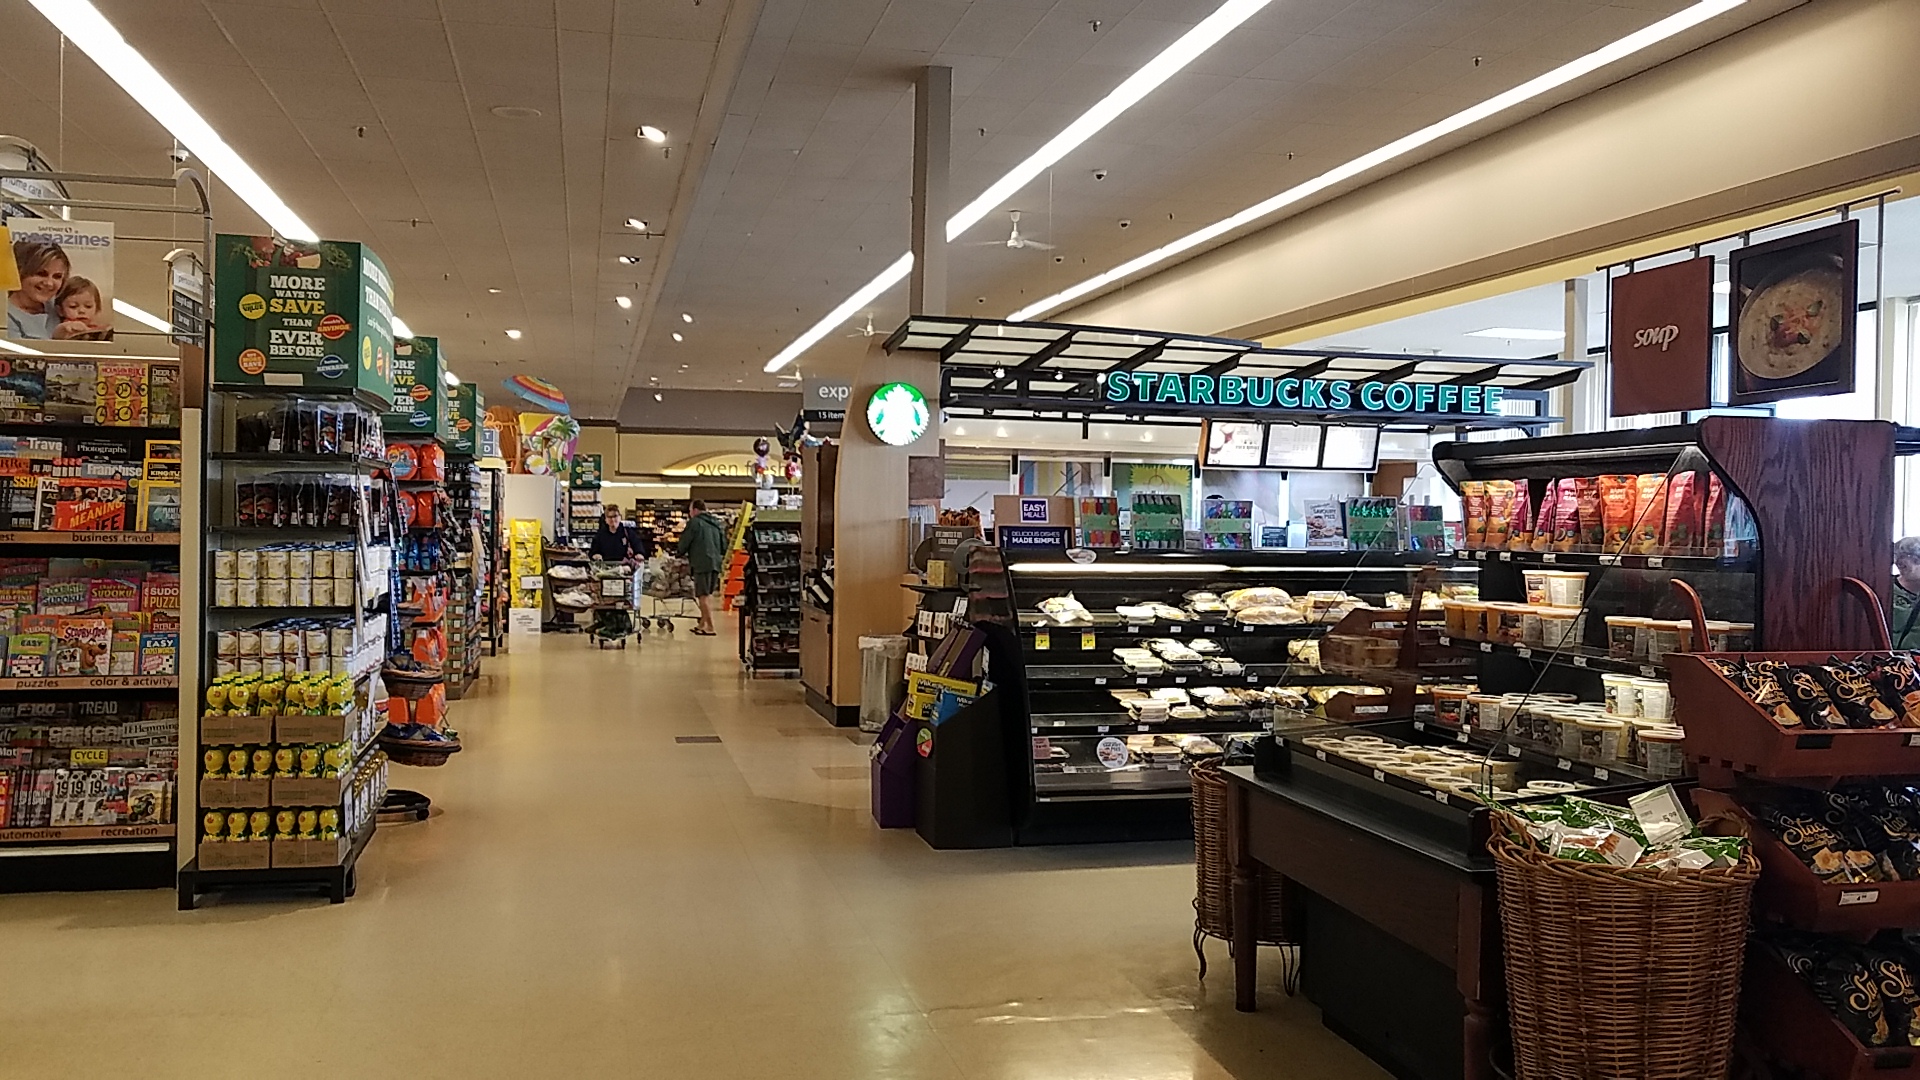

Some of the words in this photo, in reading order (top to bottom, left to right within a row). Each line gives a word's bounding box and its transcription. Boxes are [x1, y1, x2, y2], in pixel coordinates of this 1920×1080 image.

[28, 184, 42, 198] care
[12, 231, 110, 247] magazines
[270, 275, 325, 291] MORE
[275, 290, 304, 298] WAYS
[307, 291, 320, 299] TO
[269, 298, 325, 314] SAVE
[282, 318, 312, 327] THAN
[317, 324, 350, 332] SAVINGS
[269, 330, 323, 345] EVER
[1633, 324, 1680, 352] soup
[269, 345, 324, 357] BEFORE
[317, 364, 350, 372] REWARDS
[393, 360, 416, 369] ORE
[129, 368, 146, 377] BIKE
[152, 368, 170, 376] DEER
[393, 376, 415, 386] AVE
[1106, 370, 1351, 409] STARBUCKS
[1361, 381, 1505, 415] COFFEE
[818, 411, 827, 419] 15
[77, 444, 127, 454] Photographs
[87, 463, 143, 477] Franchise
[696, 464, 738, 476] oven
[744, 461, 786, 477] fsh
[73, 501, 91, 513] THE
[69, 500, 124, 528] MEANING
[95, 514, 121, 530] IFE
[72, 533, 117, 542] business
[123, 533, 154, 542] travel
[91, 589, 135, 598] SUDOKU!
[153, 623, 180, 631] BIBLE
[146, 640, 174, 648] EASY
[16, 679, 59, 688] puzzles
[90, 677, 119, 686] color
[121, 677, 130, 686] &
[132, 676, 173, 687] activity
[79, 701, 118, 714] TREAD
[75, 751, 104, 760] CYCLE
[101, 827, 158, 836] recreation
